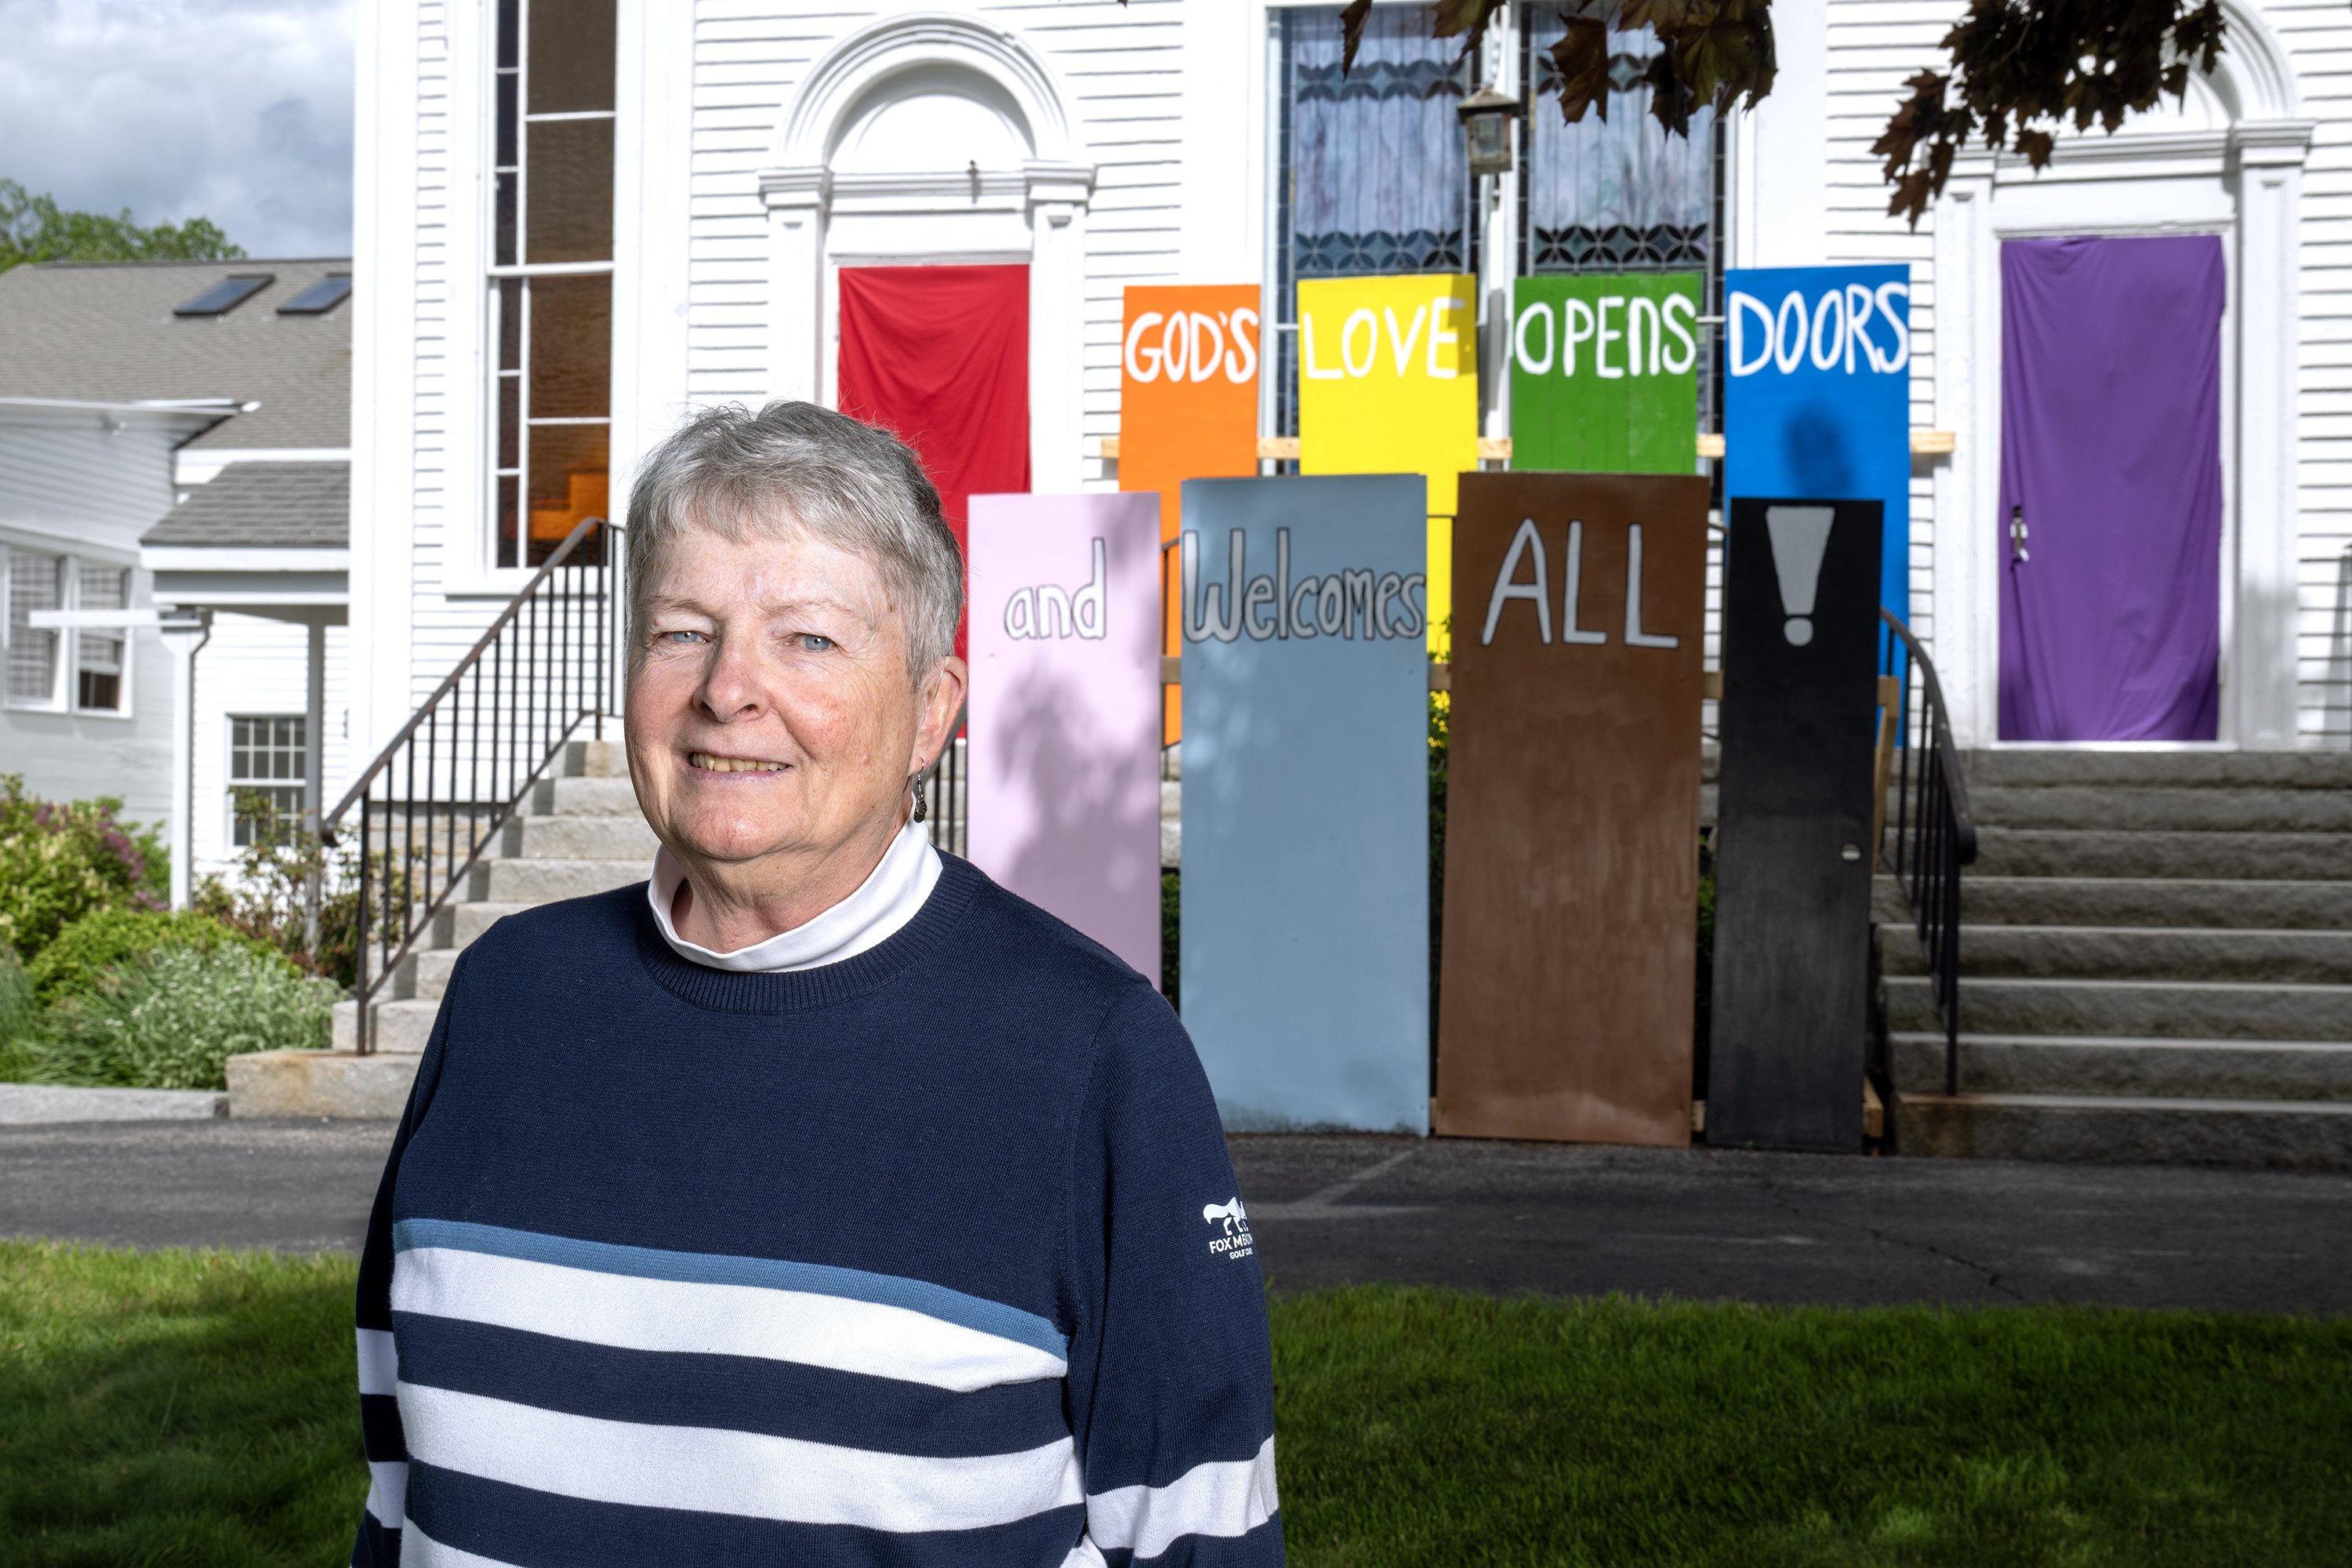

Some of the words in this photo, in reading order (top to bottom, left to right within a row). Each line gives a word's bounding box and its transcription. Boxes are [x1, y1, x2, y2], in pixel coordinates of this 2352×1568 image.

[1124, 307, 1258, 383] GOD'S
[1302, 296, 1466, 379] LOVE
[1514, 292, 1697, 379] OPENS
[1728, 281, 1909, 377] DOORS
[1004, 536, 1107, 641] and
[1182, 527, 1426, 644] Welcomes
[1481, 517, 1679, 649] ALL
[1766, 505, 1835, 647] !
[1209, 1237, 1232, 1254] FOX
[1229, 1250, 1245, 1260] GOLF
